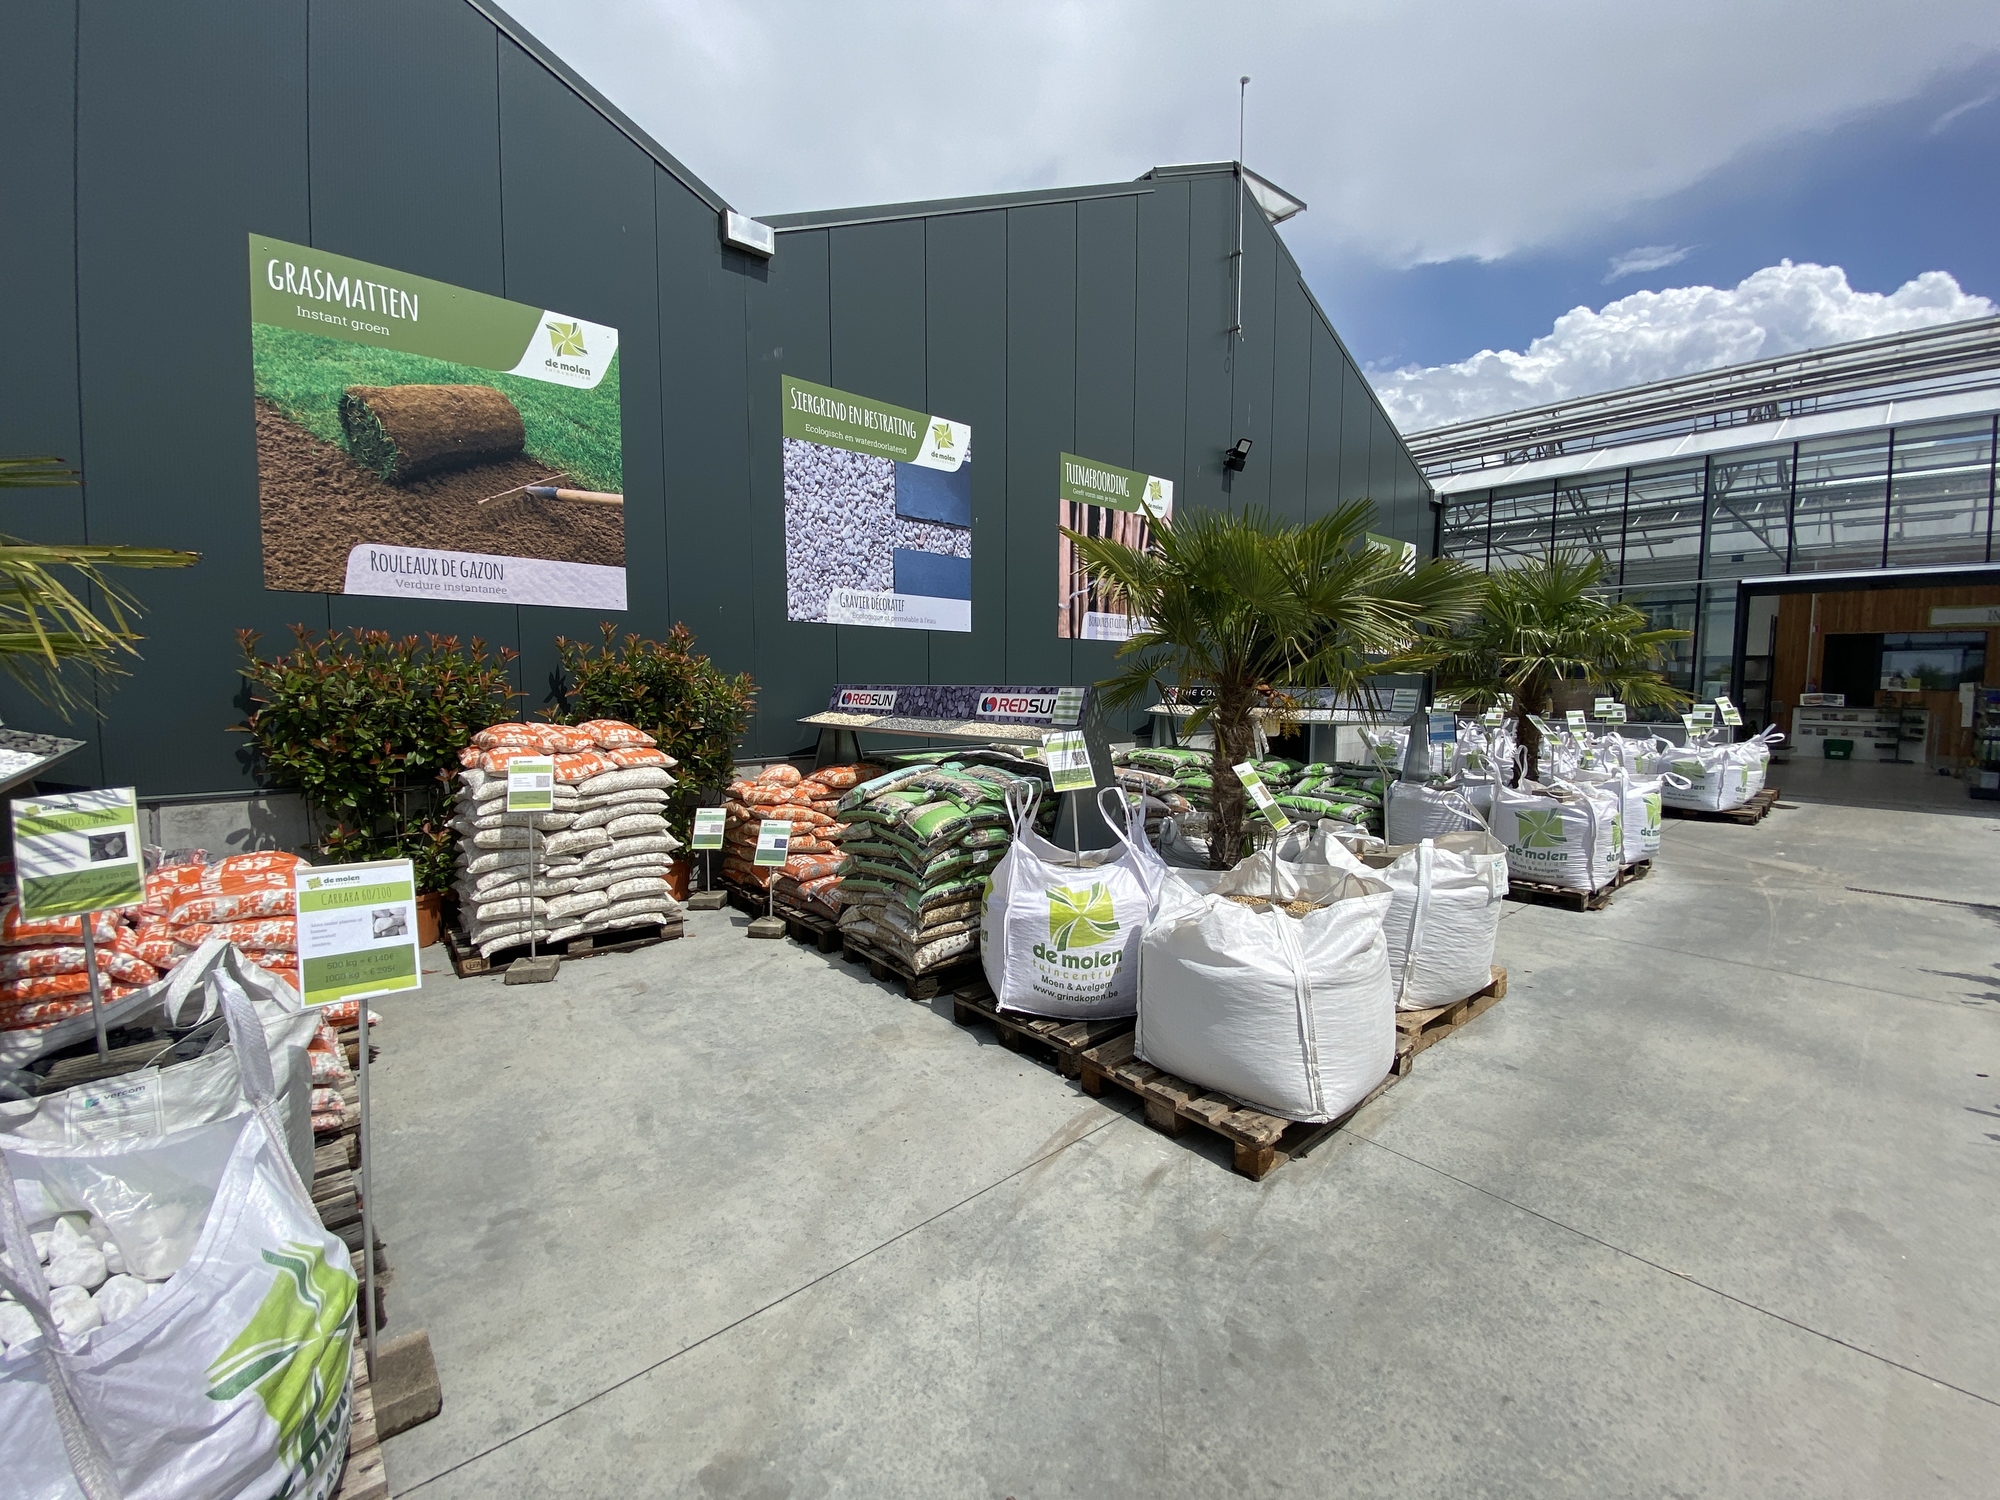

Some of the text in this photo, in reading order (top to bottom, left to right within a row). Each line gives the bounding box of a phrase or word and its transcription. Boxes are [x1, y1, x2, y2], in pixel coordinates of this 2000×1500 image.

[267, 258, 419, 321] GRASMATTEN
[296, 305, 390, 336] Instant groen
[545, 358, 591, 376] de molen
[790, 387, 917, 440] SIERGRIND EN BESTRATING
[805, 423, 908, 455] Ecologisch en waterdoorlatend
[931, 450, 938, 458] de
[939, 453, 956, 463] molen
[1064, 462, 1130, 498] TUINAFBOORDING
[370, 550, 505, 582] ROULEAUX DE GAZON
[395, 578, 508, 596] Verdure instantanée
[839, 592, 905, 613] GRAVIER DÉCORATIF
[891, 614, 919, 624] perméable
[850, 693, 894, 707] REDSUN
[1181, 688, 1198, 696] THE
[1641, 827, 1651, 836] de
[1508, 843, 1568, 861] de molen
[1512, 860, 1527, 870] Moen
[1533, 866, 1560, 874] Avelgem
[335, 875, 360, 883] molen
[321, 886, 392, 906] CARRARA 60/100
[345, 959, 358, 969] kg
[375, 952, 395, 963] 140€
[1033, 943, 1123, 969] de molen
[325, 973, 346, 984] 1000
[377, 965, 398, 975] 295€
[1032, 958, 1123, 981] tuincentrum
[1041, 974, 1065, 989] Moen
[1075, 981, 1113, 992] Avelgem
[1032, 983, 1119, 1003] www.grindkopen.be
[104, 1085, 146, 1100] vercom
